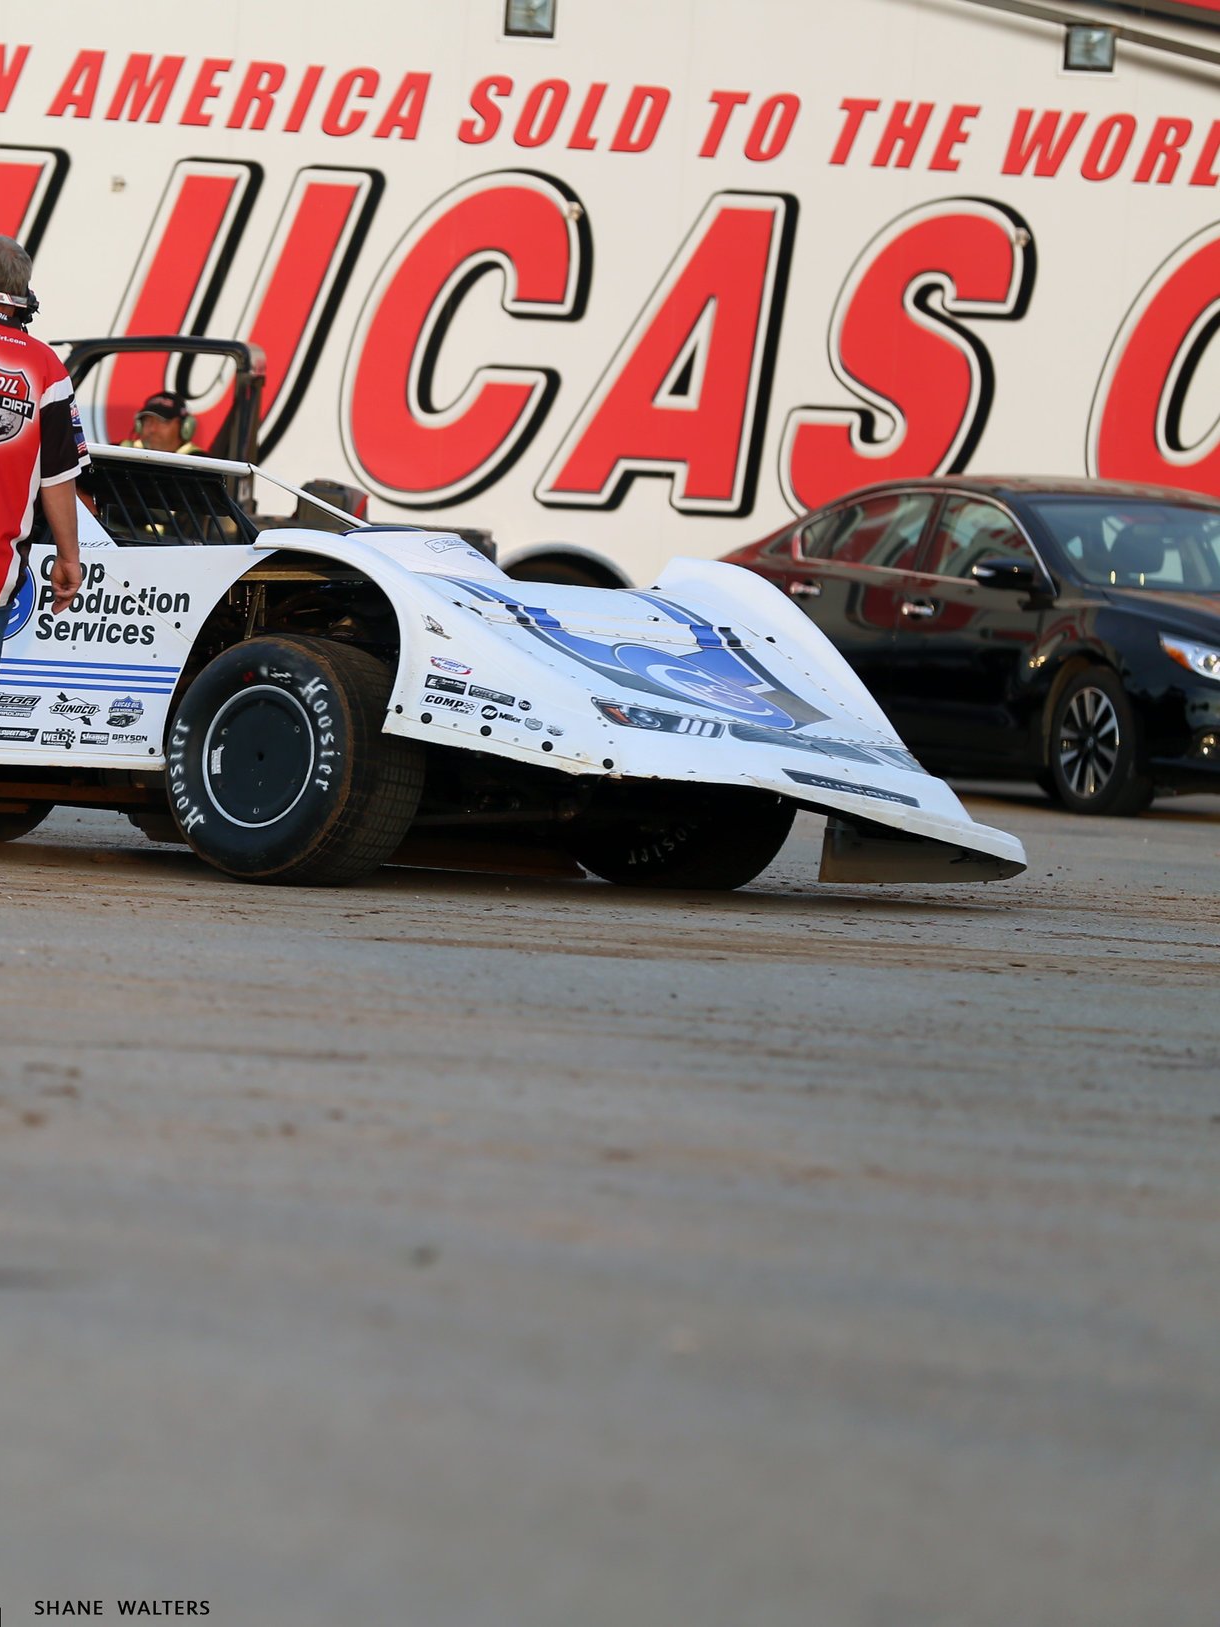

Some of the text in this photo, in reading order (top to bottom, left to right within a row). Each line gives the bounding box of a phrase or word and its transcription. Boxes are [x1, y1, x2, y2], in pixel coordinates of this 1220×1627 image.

[46, 50, 432, 141] AMERICA
[457, 75, 671, 153] SOLD
[699, 90, 801, 162] TO
[829, 98, 982, 172] THE
[2, 397, 33, 416] DIRT
[40, 554, 106, 586] Cp
[37, 586, 191, 617] Poduction
[35, 613, 156, 646] Services
[52, 704, 97, 714] SUNOCO
[424, 695, 465, 708] COMP
[499, 712, 522, 723] Miller
[43, 732, 68, 742] WELD
[112, 733, 148, 741] BRYSON
[298, 676, 341, 792] Hoosier
[170, 717, 206, 834] Hoosier
